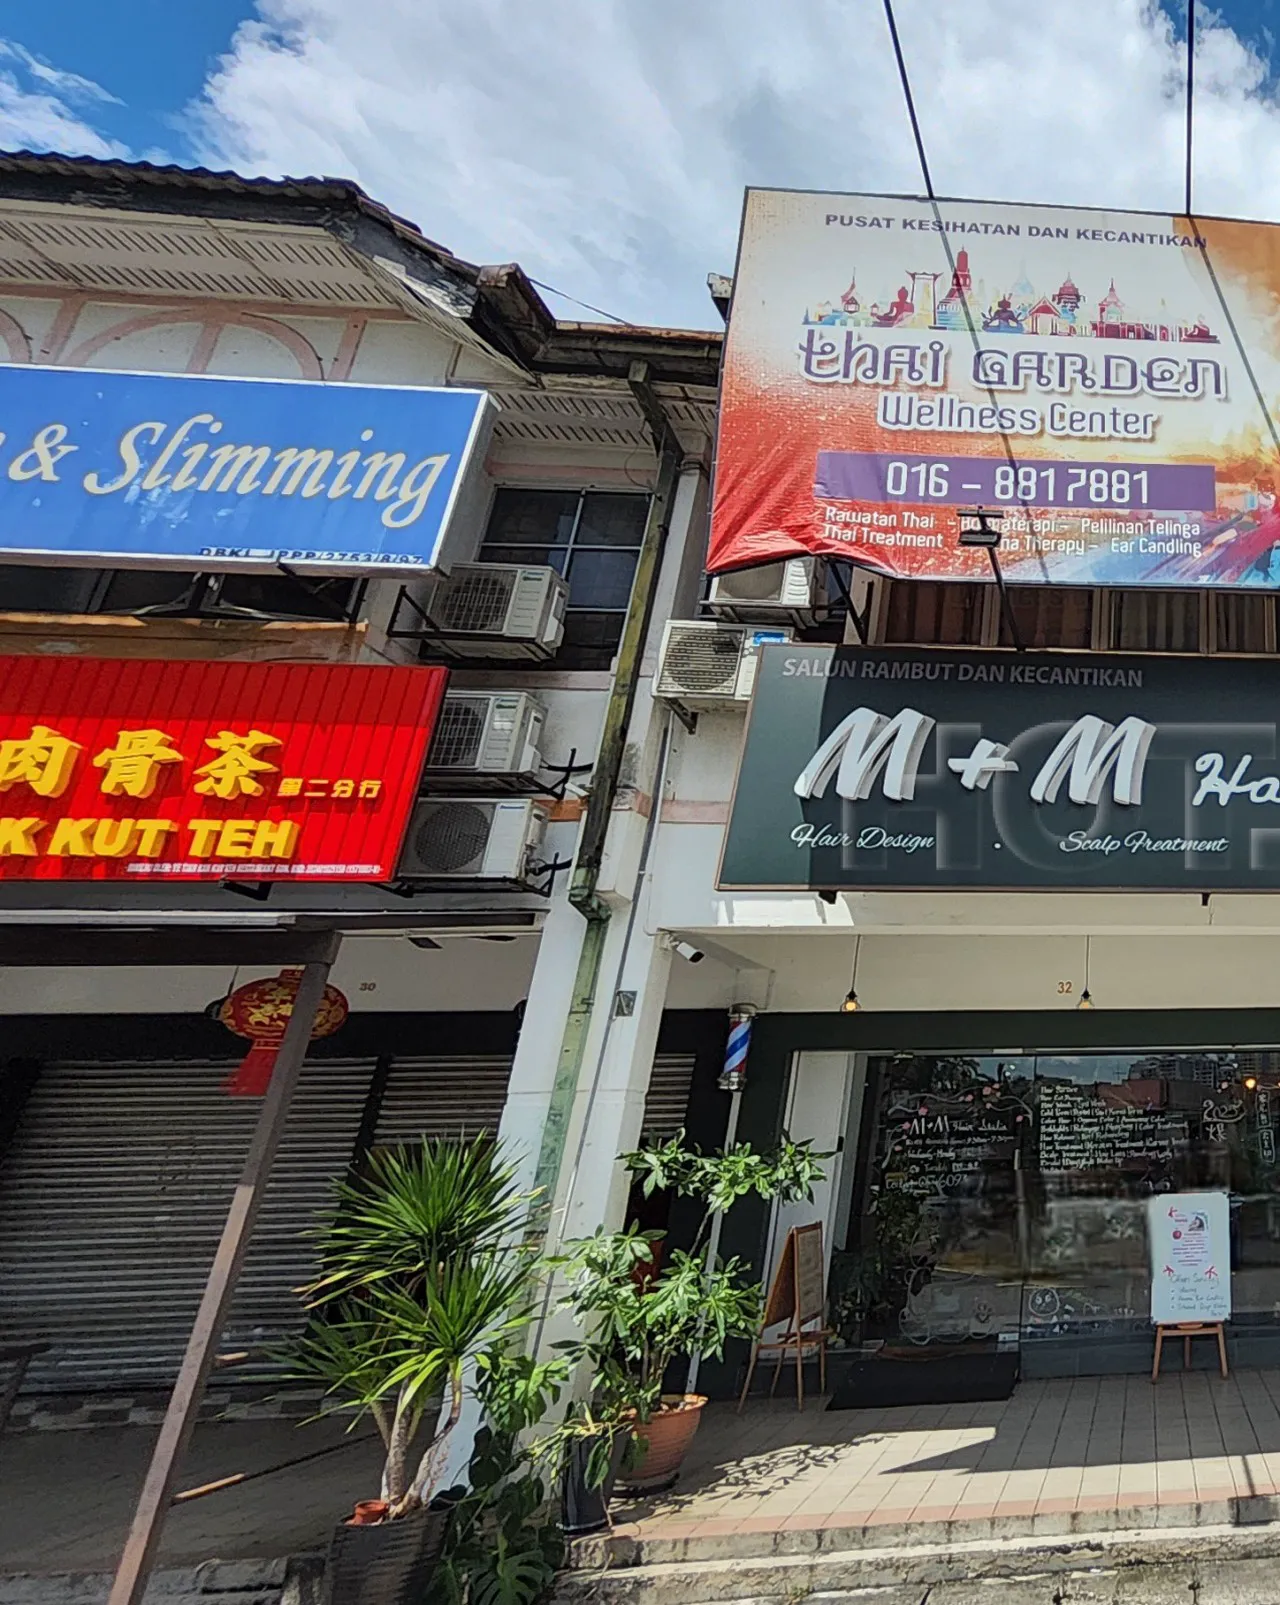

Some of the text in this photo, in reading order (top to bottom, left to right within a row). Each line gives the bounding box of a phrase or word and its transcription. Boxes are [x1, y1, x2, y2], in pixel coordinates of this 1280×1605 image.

[826, 213, 1208, 249] PUSAT KESIHATAN DAN KECANTIKAN
[881, 395, 1155, 437] Wellness Center
[7, 412, 452, 529] & Slimming
[886, 461, 950, 498] 016
[825, 506, 897, 528] Rawatan
[902, 511, 936, 530] Thai
[1148, 519, 1201, 540] Telinga
[861, 527, 943, 548] Treatment
[1024, 536, 1085, 556] Therapy
[1110, 537, 1136, 554] Ear
[1139, 538, 1203, 558] Candling
[783, 658, 1144, 689] SALUN RAMBUT DAN KECANTIKAN
[793, 706, 936, 802] M
[1030, 713, 1158, 806] M
[276, 776, 382, 800] 第二分行
[47, 817, 180, 858] KUT
[188, 818, 300, 859] TEH
[790, 822, 853, 850] Hair
[857, 825, 936, 854] Design
[1059, 830, 1119, 855] Scalp
[1057, 981, 1072, 994] 32
